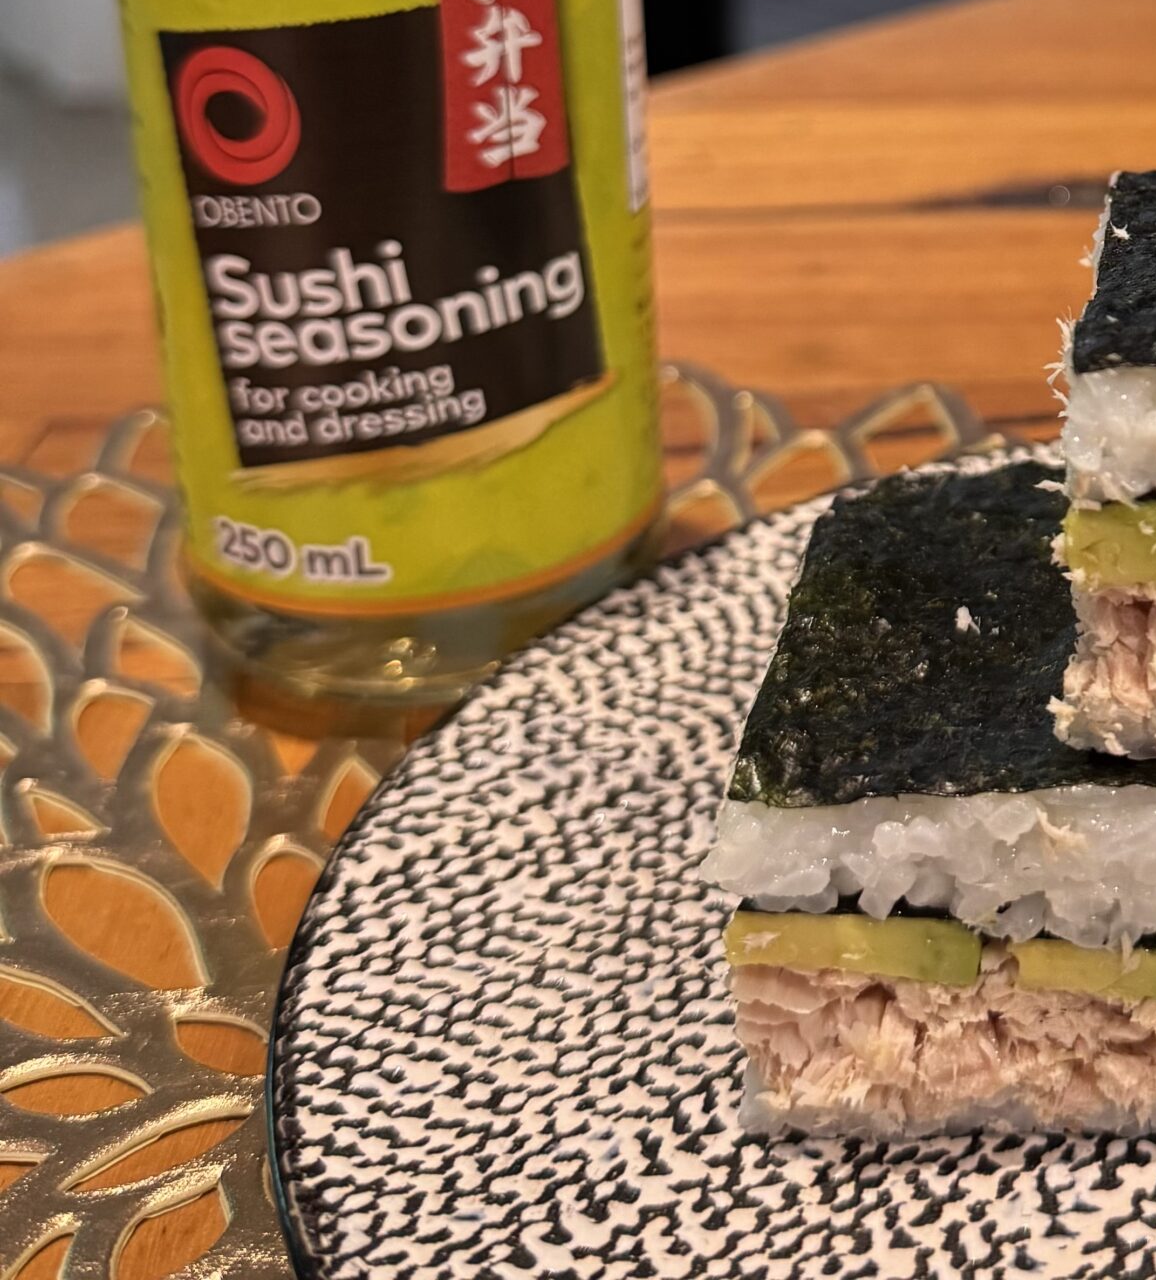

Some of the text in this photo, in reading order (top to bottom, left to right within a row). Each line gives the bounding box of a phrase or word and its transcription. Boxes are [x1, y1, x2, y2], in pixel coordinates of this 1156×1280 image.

[194, 192, 322, 228] OBENTO
[209, 240, 411, 318] Sushi
[217, 251, 586, 368] seasoning
[234, 363, 455, 412] for cooking
[239, 387, 486, 447] and dressing
[218, 520, 388, 578] 250 mL
